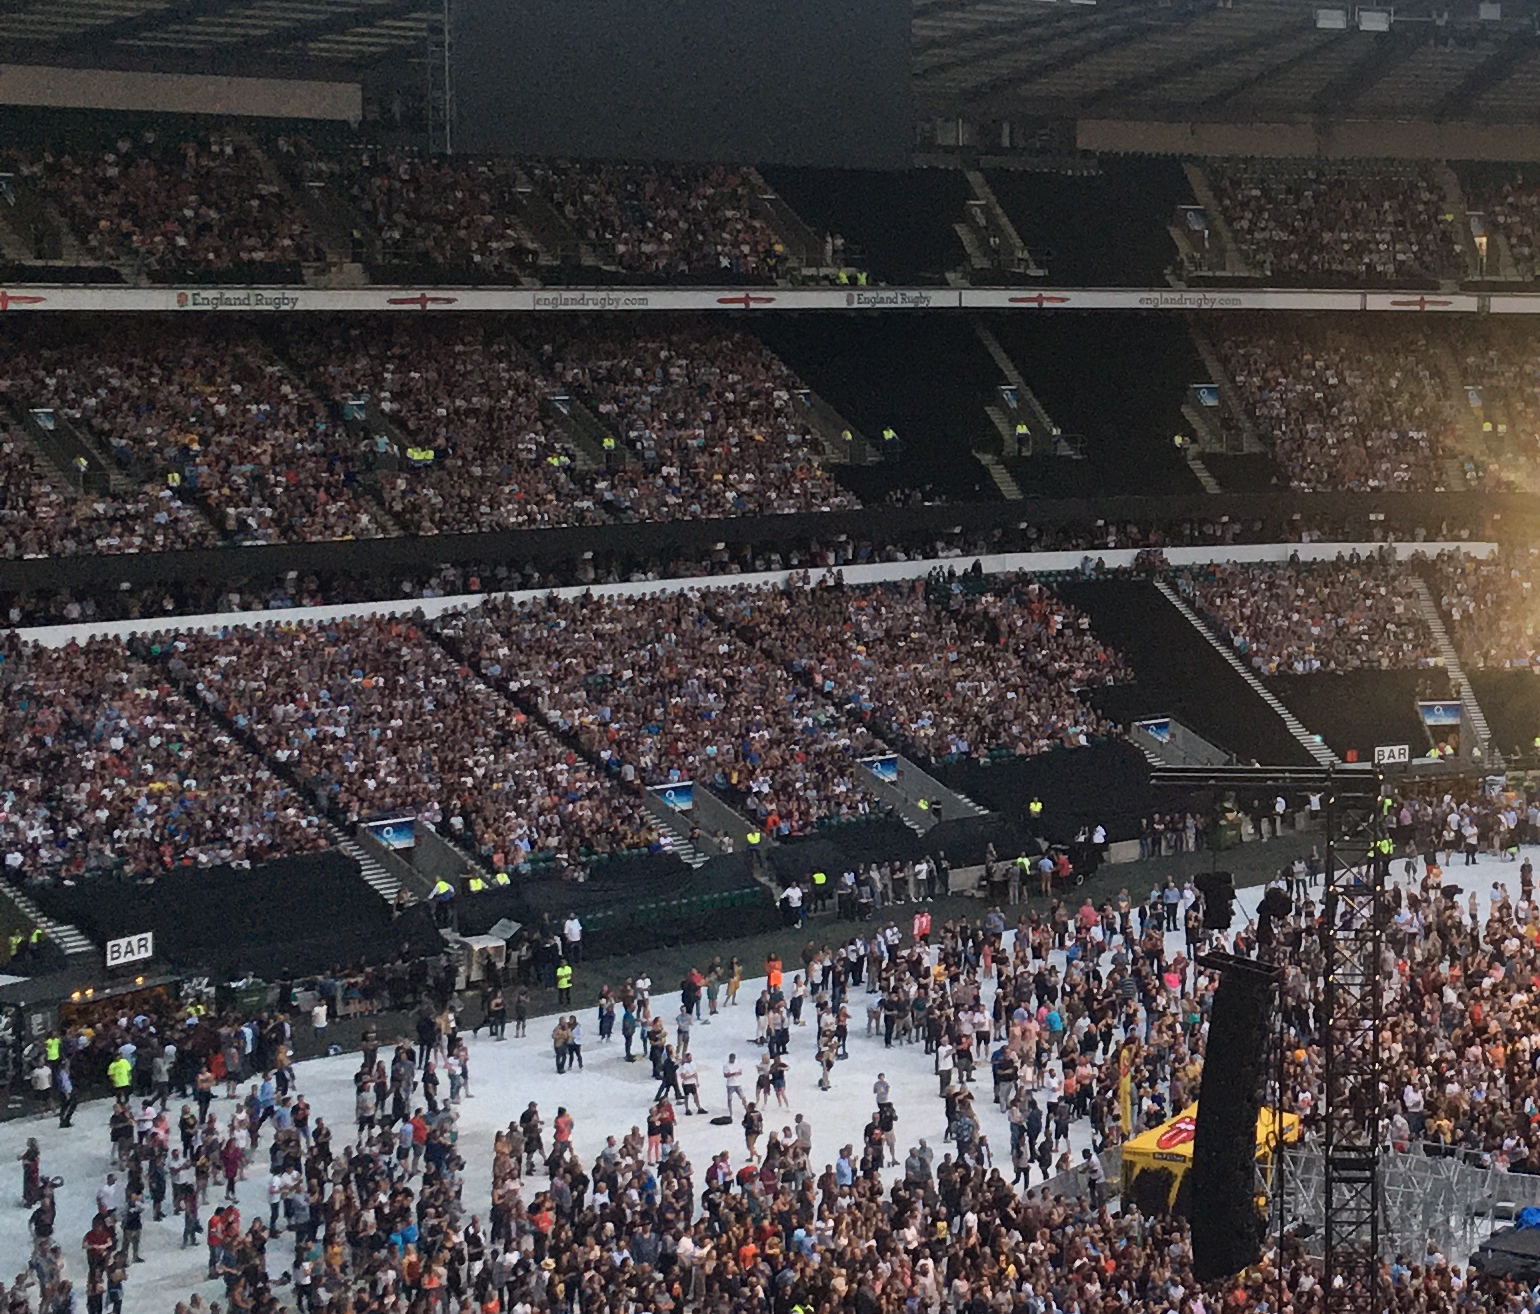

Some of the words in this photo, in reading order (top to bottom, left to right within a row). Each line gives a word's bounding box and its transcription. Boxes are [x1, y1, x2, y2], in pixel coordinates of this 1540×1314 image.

[192, 293, 252, 308] England
[255, 293, 299, 308] Rugby
[857, 293, 899, 306] England
[900, 293, 932, 306] Rugby
[1377, 748, 1406, 761] BAR
[110, 937, 149, 961] BAR
